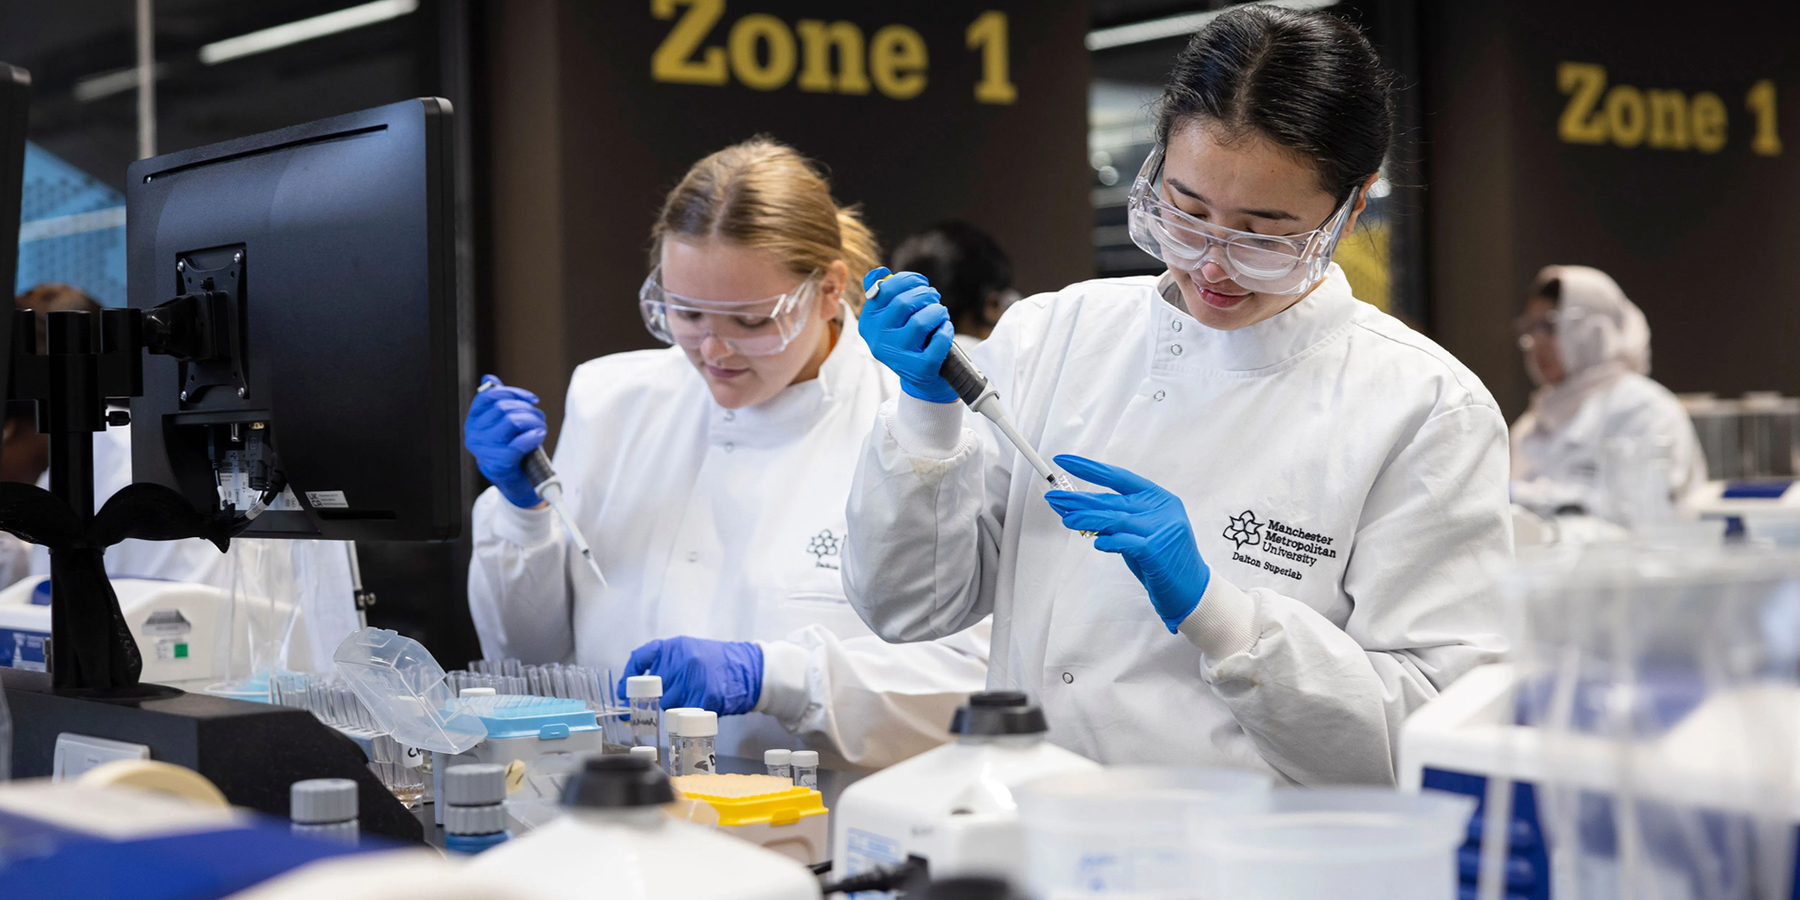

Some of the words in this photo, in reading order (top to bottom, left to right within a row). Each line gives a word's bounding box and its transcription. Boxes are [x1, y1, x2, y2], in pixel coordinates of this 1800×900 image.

[651, 0, 928, 100] Zone
[965, 9, 1018, 104] 1
[1556, 60, 1728, 154] Zone
[1745, 78, 1783, 156] 1
[1264, 530, 1337, 558] Metropolitan
[1267, 519, 1334, 546] Manchester
[1232, 552, 1261, 568] Dalton
[1263, 561, 1303, 581] Superlab
[1262, 541, 1318, 567] University
